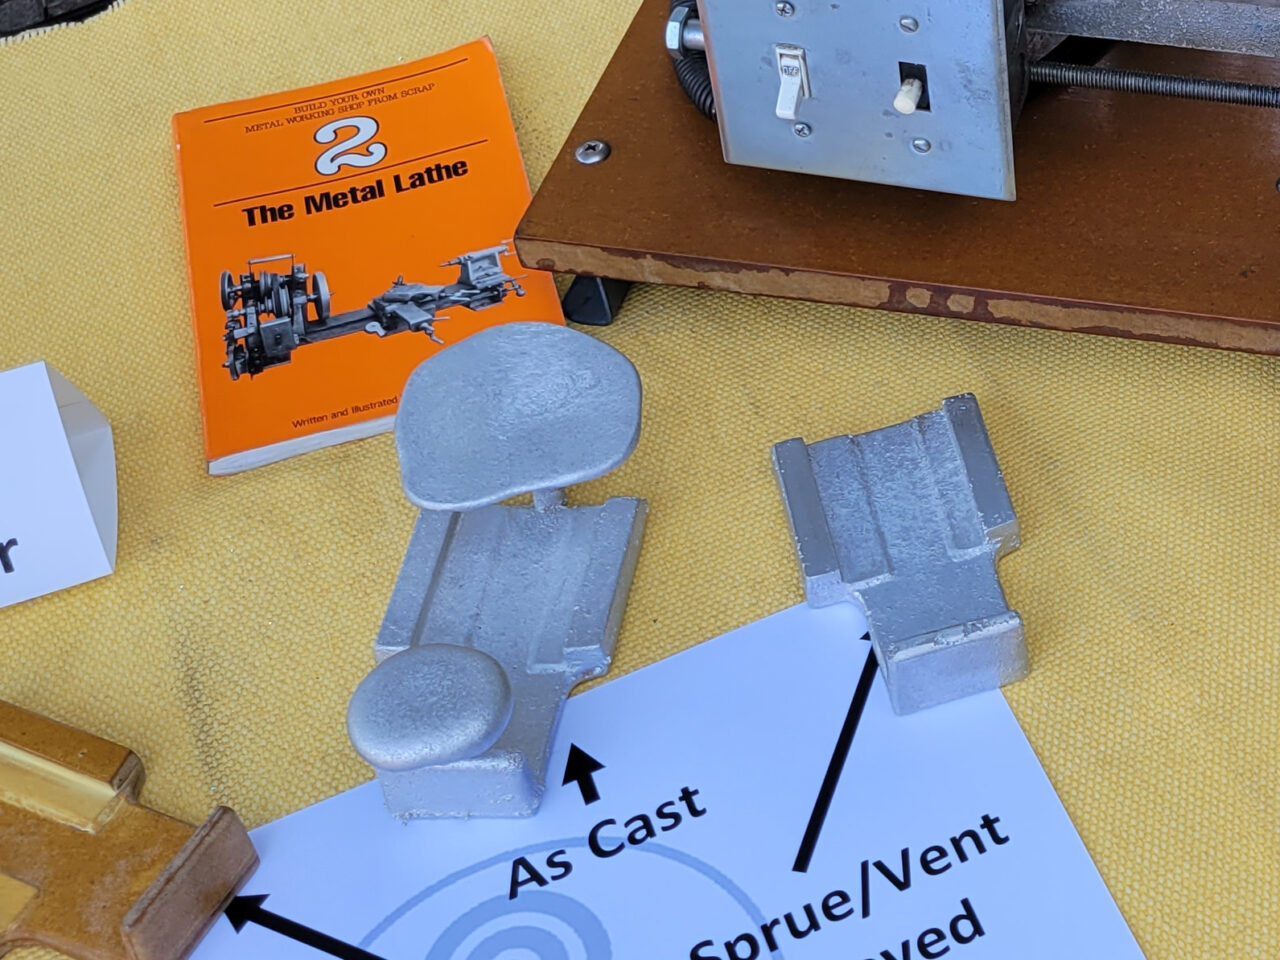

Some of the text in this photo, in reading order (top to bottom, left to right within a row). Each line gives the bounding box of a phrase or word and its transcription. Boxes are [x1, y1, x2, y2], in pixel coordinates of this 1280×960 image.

[244, 83, 436, 134] METAL WORKING SHOP FROM SCRAP
[294, 87, 386, 114] BUILD YOUR OWN
[313, 115, 388, 176] 2
[242, 160, 469, 227] The Metal Lathe
[291, 395, 399, 429] Written and Illustrated
[509, 786, 707, 900] As Cast
